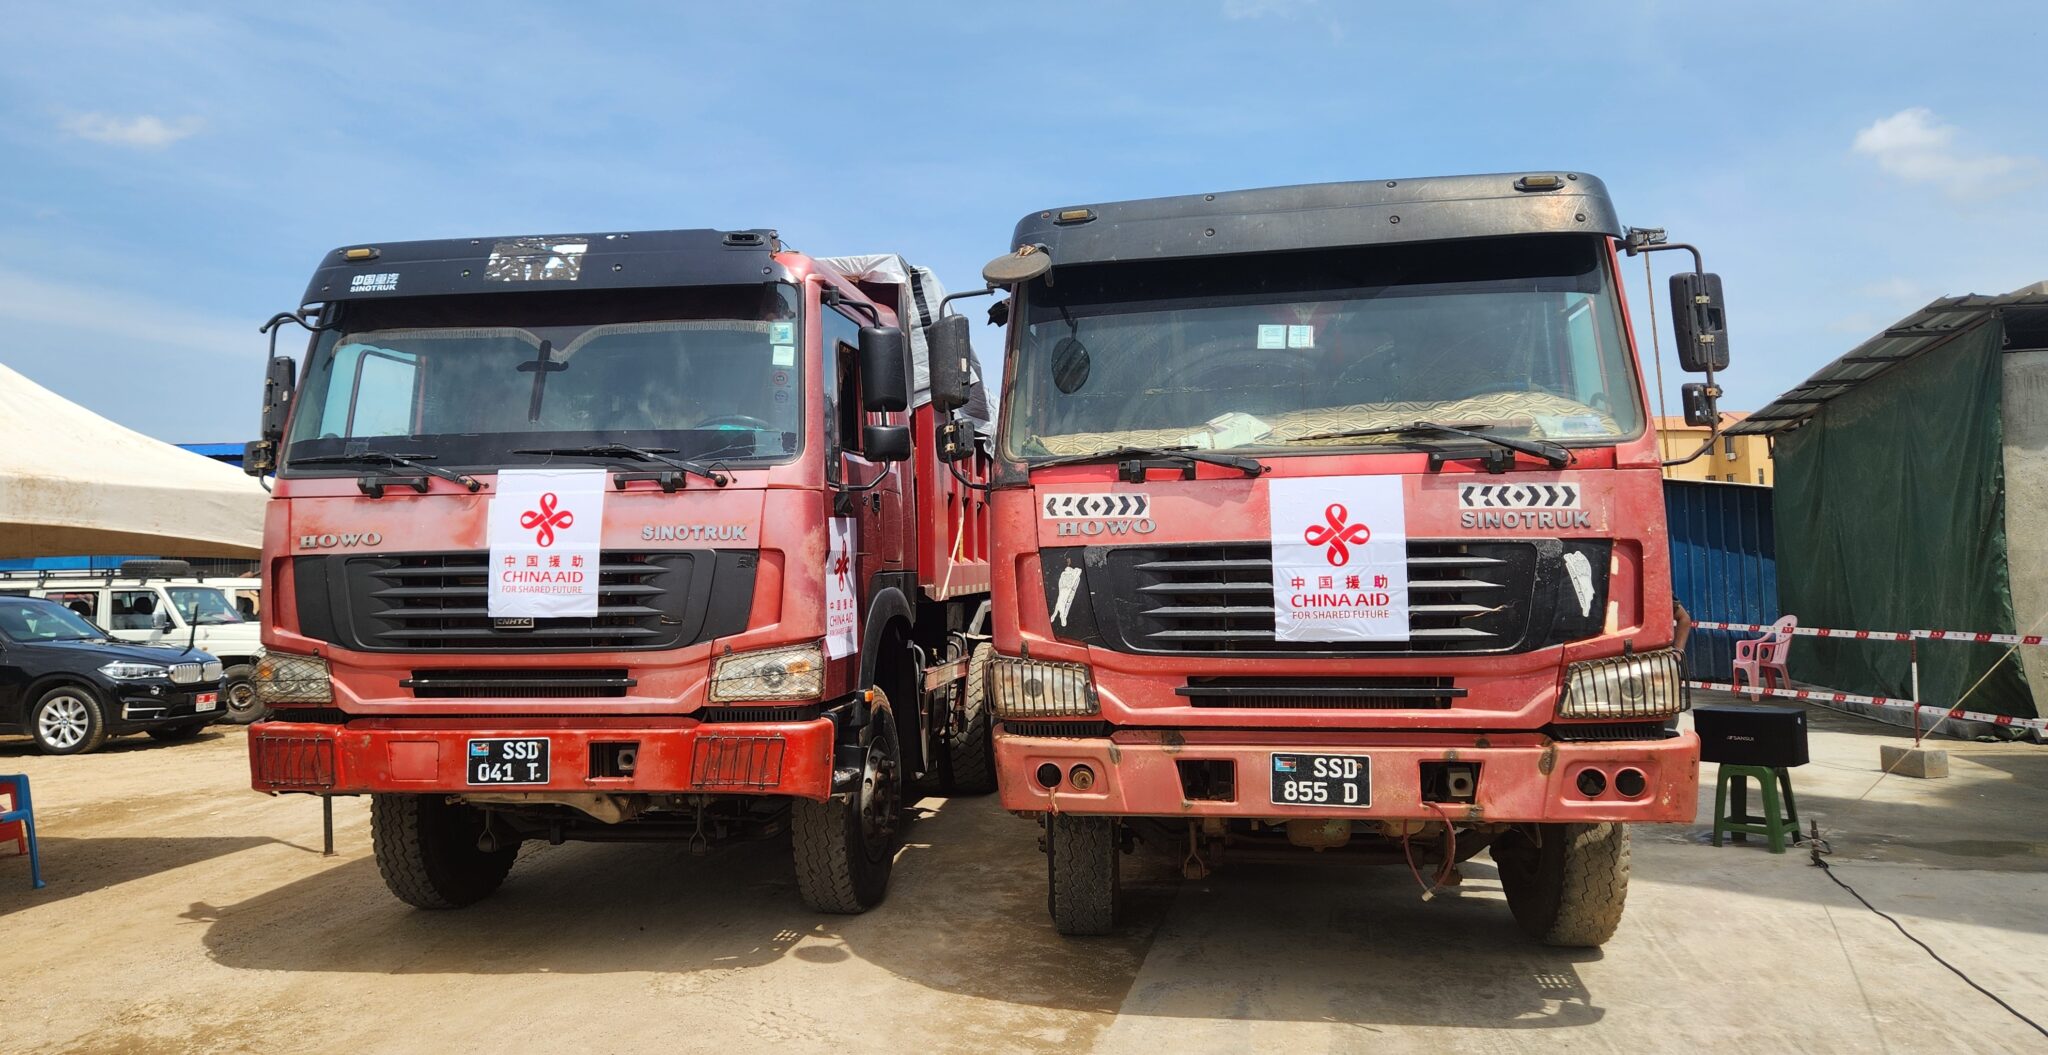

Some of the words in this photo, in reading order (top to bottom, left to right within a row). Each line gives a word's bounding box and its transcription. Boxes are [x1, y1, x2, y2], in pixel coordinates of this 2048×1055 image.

[350, 284, 396, 292] SINOTRUK
[1461, 511, 1590, 528] SINOTRUK
[642, 525, 747, 540] SINOTRUK
[1057, 519, 1156, 536] HOWO
[299, 533, 382, 548] HOWO
[504, 555, 584, 567] 中国援助
[503, 571, 552, 583] CHINA
[555, 571, 583, 583] AID
[1291, 575, 1388, 590] 中国援助
[502, 585, 517, 593] FOR
[519, 585, 550, 593] SHARED
[553, 585, 582, 593] FUTURE
[1291, 594, 1351, 607] CHINA
[1355, 593, 1389, 606] AID
[1293, 611, 1311, 619] FOR
[1313, 610, 1350, 619] SHARED
[1353, 609, 1389, 618] FUTURE
[503, 742, 539, 759] SSD
[478, 763, 514, 781] 041
[1314, 758, 1358, 778] SSD
[1284, 781, 1328, 802] 855
[1343, 783, 1358, 803] D
